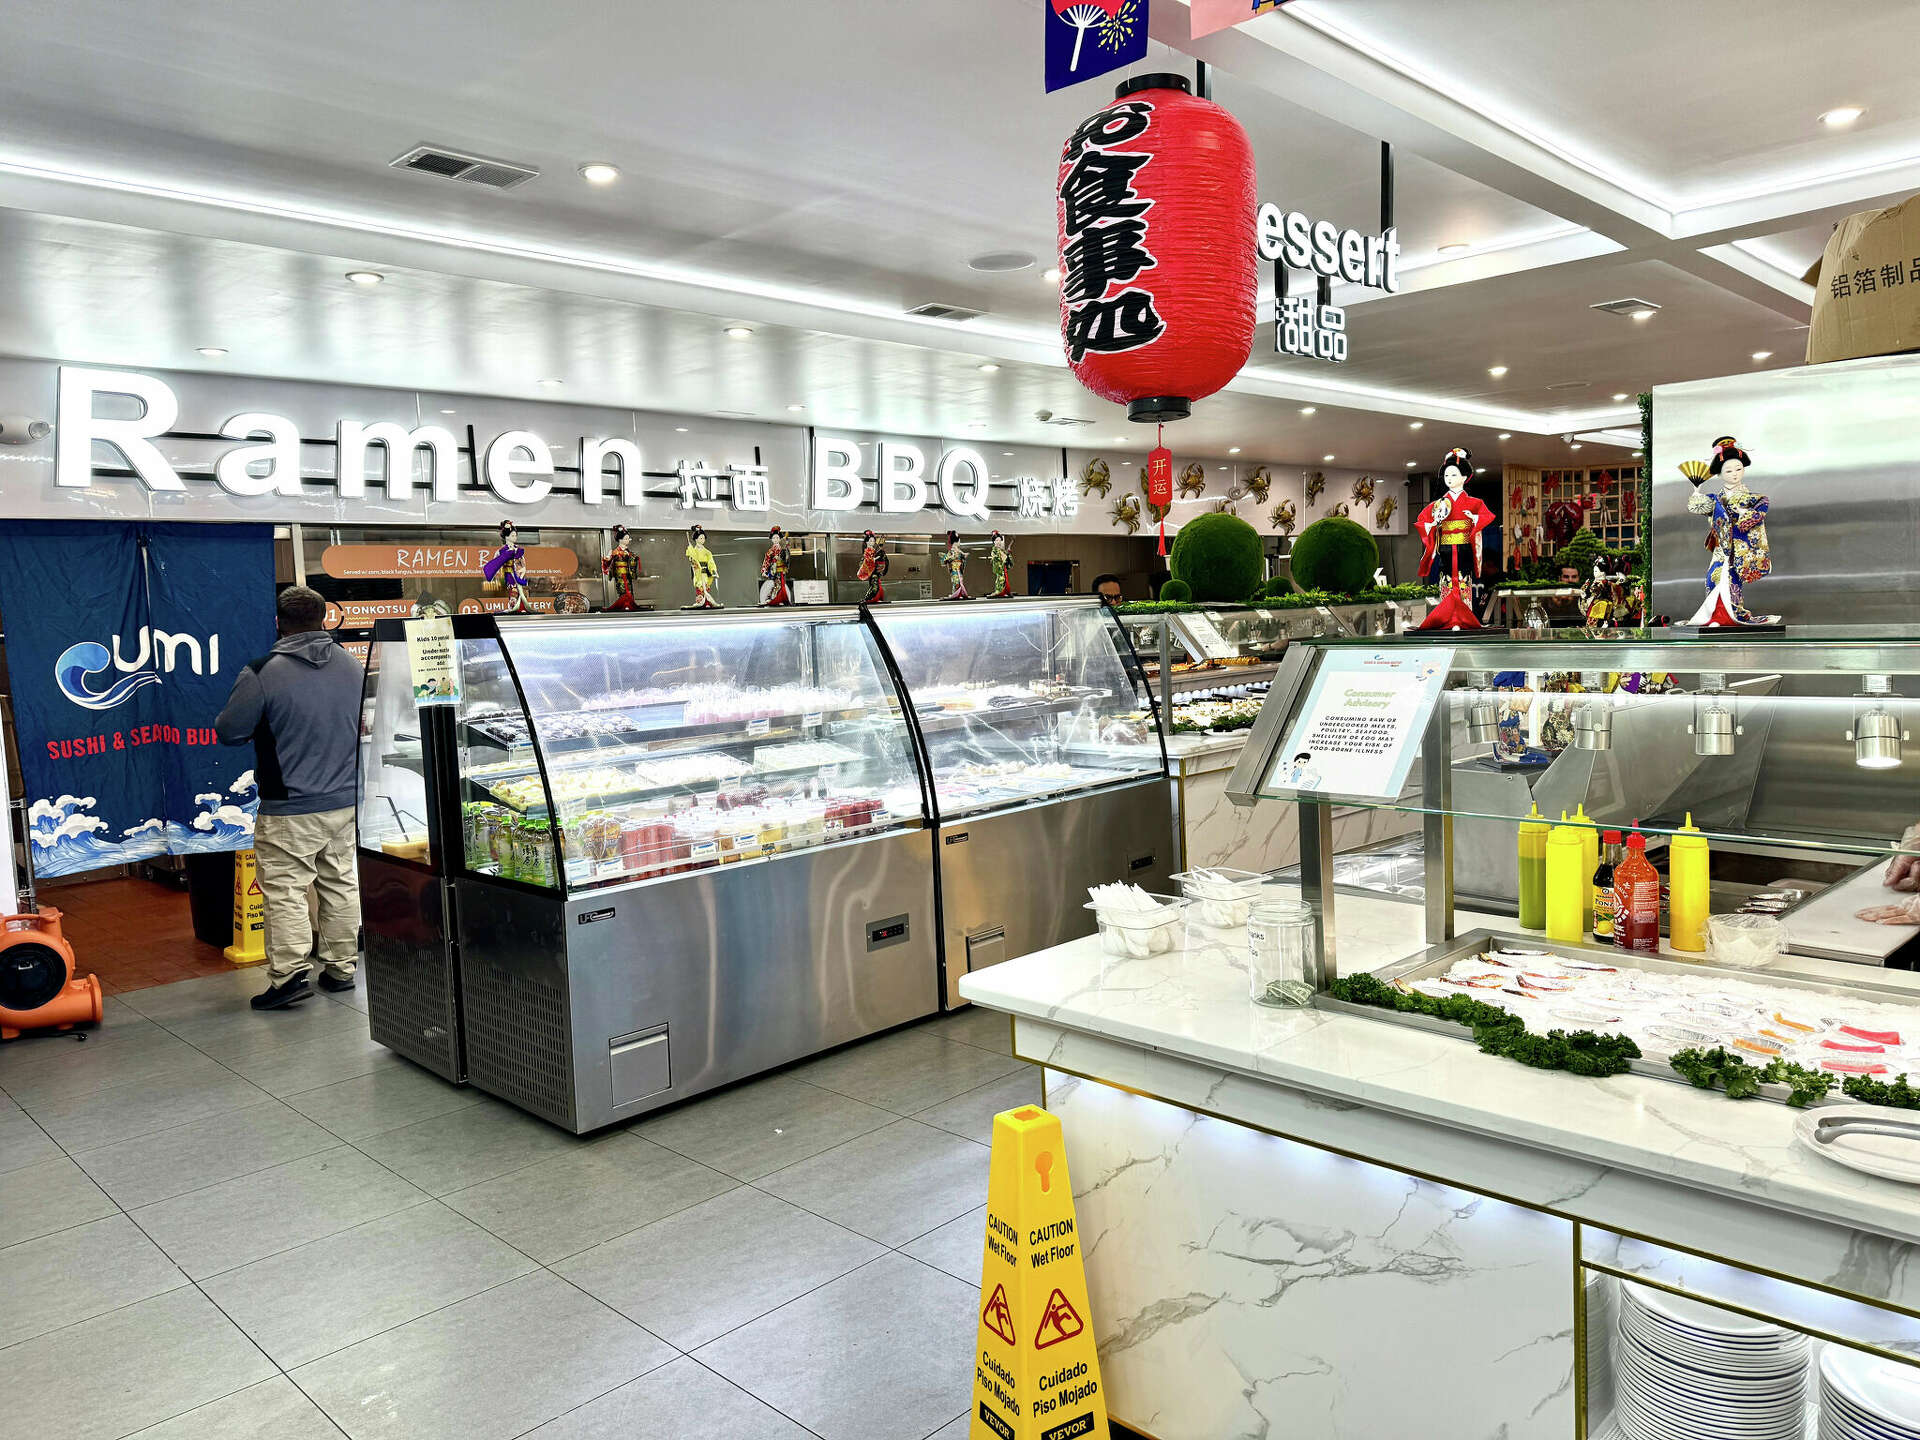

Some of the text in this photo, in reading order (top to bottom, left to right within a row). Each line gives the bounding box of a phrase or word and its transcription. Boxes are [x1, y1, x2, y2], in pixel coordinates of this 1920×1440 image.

[1257, 202, 1400, 294] essert
[1275, 297, 1347, 362] 甜品
[56, 365, 643, 507] Ramen
[677, 459, 770, 512] 拉面
[811, 436, 990, 520] BBQ
[1152, 458, 1168, 495] 开运
[397, 548, 468, 568] RAMEN
[345, 604, 407, 615] TONKOTSU
[485, 602, 504, 611] UMI
[348, 645, 368, 654] MIS
[46, 734, 106, 760] SUSHI
[113, 731, 125, 750] &
[988, 1213, 1018, 1247] CAUTION
[1029, 1218, 1074, 1246] CAUTION
[988, 1234, 1017, 1268] Wet Floor
[1031, 1244, 1075, 1269] Wet Floor
[982, 1351, 1016, 1389] Cuidado
[1039, 1361, 1088, 1391] Cuidado
[977, 1366, 1020, 1417] Piso Mojado
[1033, 1380, 1098, 1418] Piso Mojado
[983, 1408, 1010, 1440] VEVOR
[1048, 1419, 1087, 1440] VEVOR
